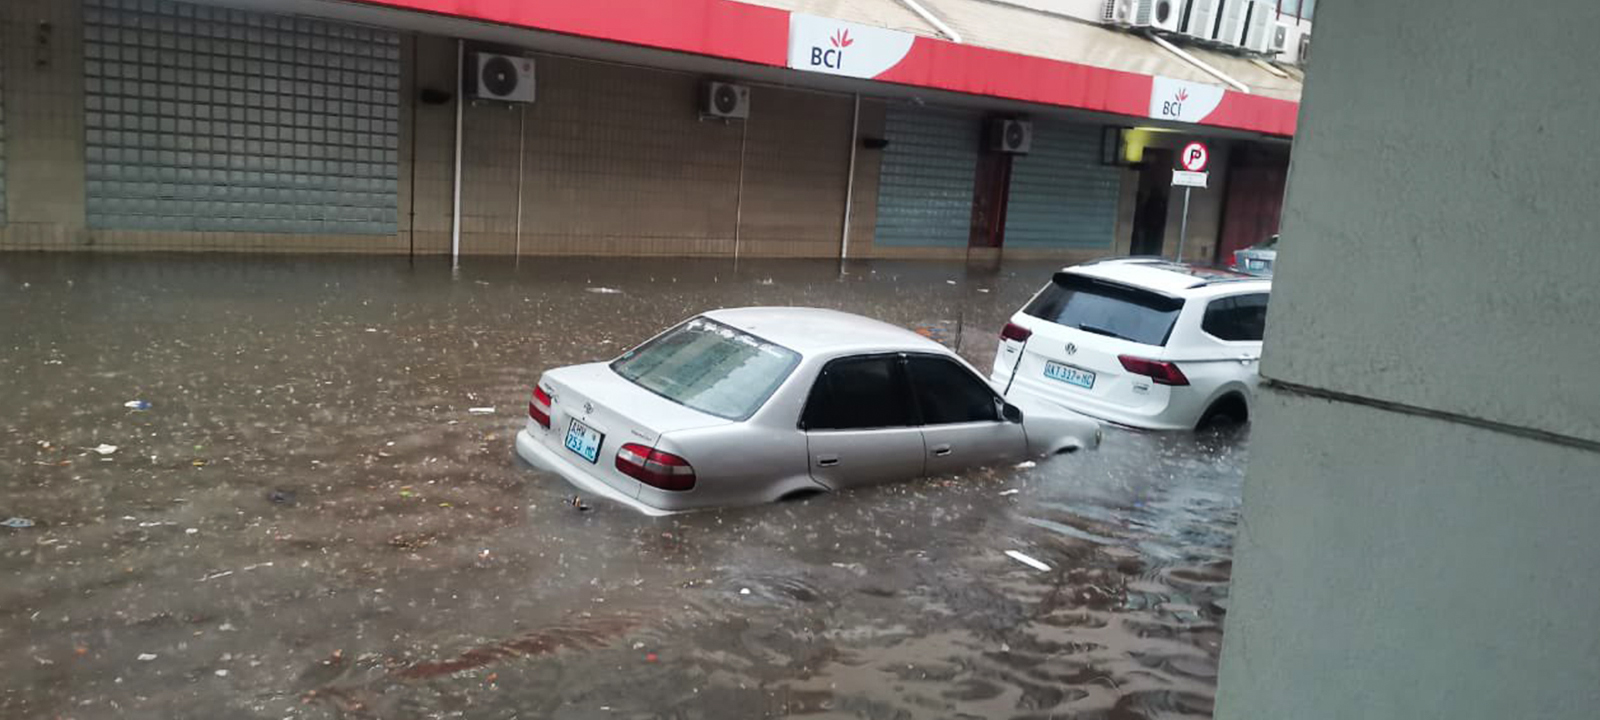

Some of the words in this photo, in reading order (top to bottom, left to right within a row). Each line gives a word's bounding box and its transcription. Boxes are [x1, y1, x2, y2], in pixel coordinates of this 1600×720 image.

[811, 46, 842, 69] BCI
[1163, 101, 1182, 116] BCI
[567, 433, 583, 451] 753
